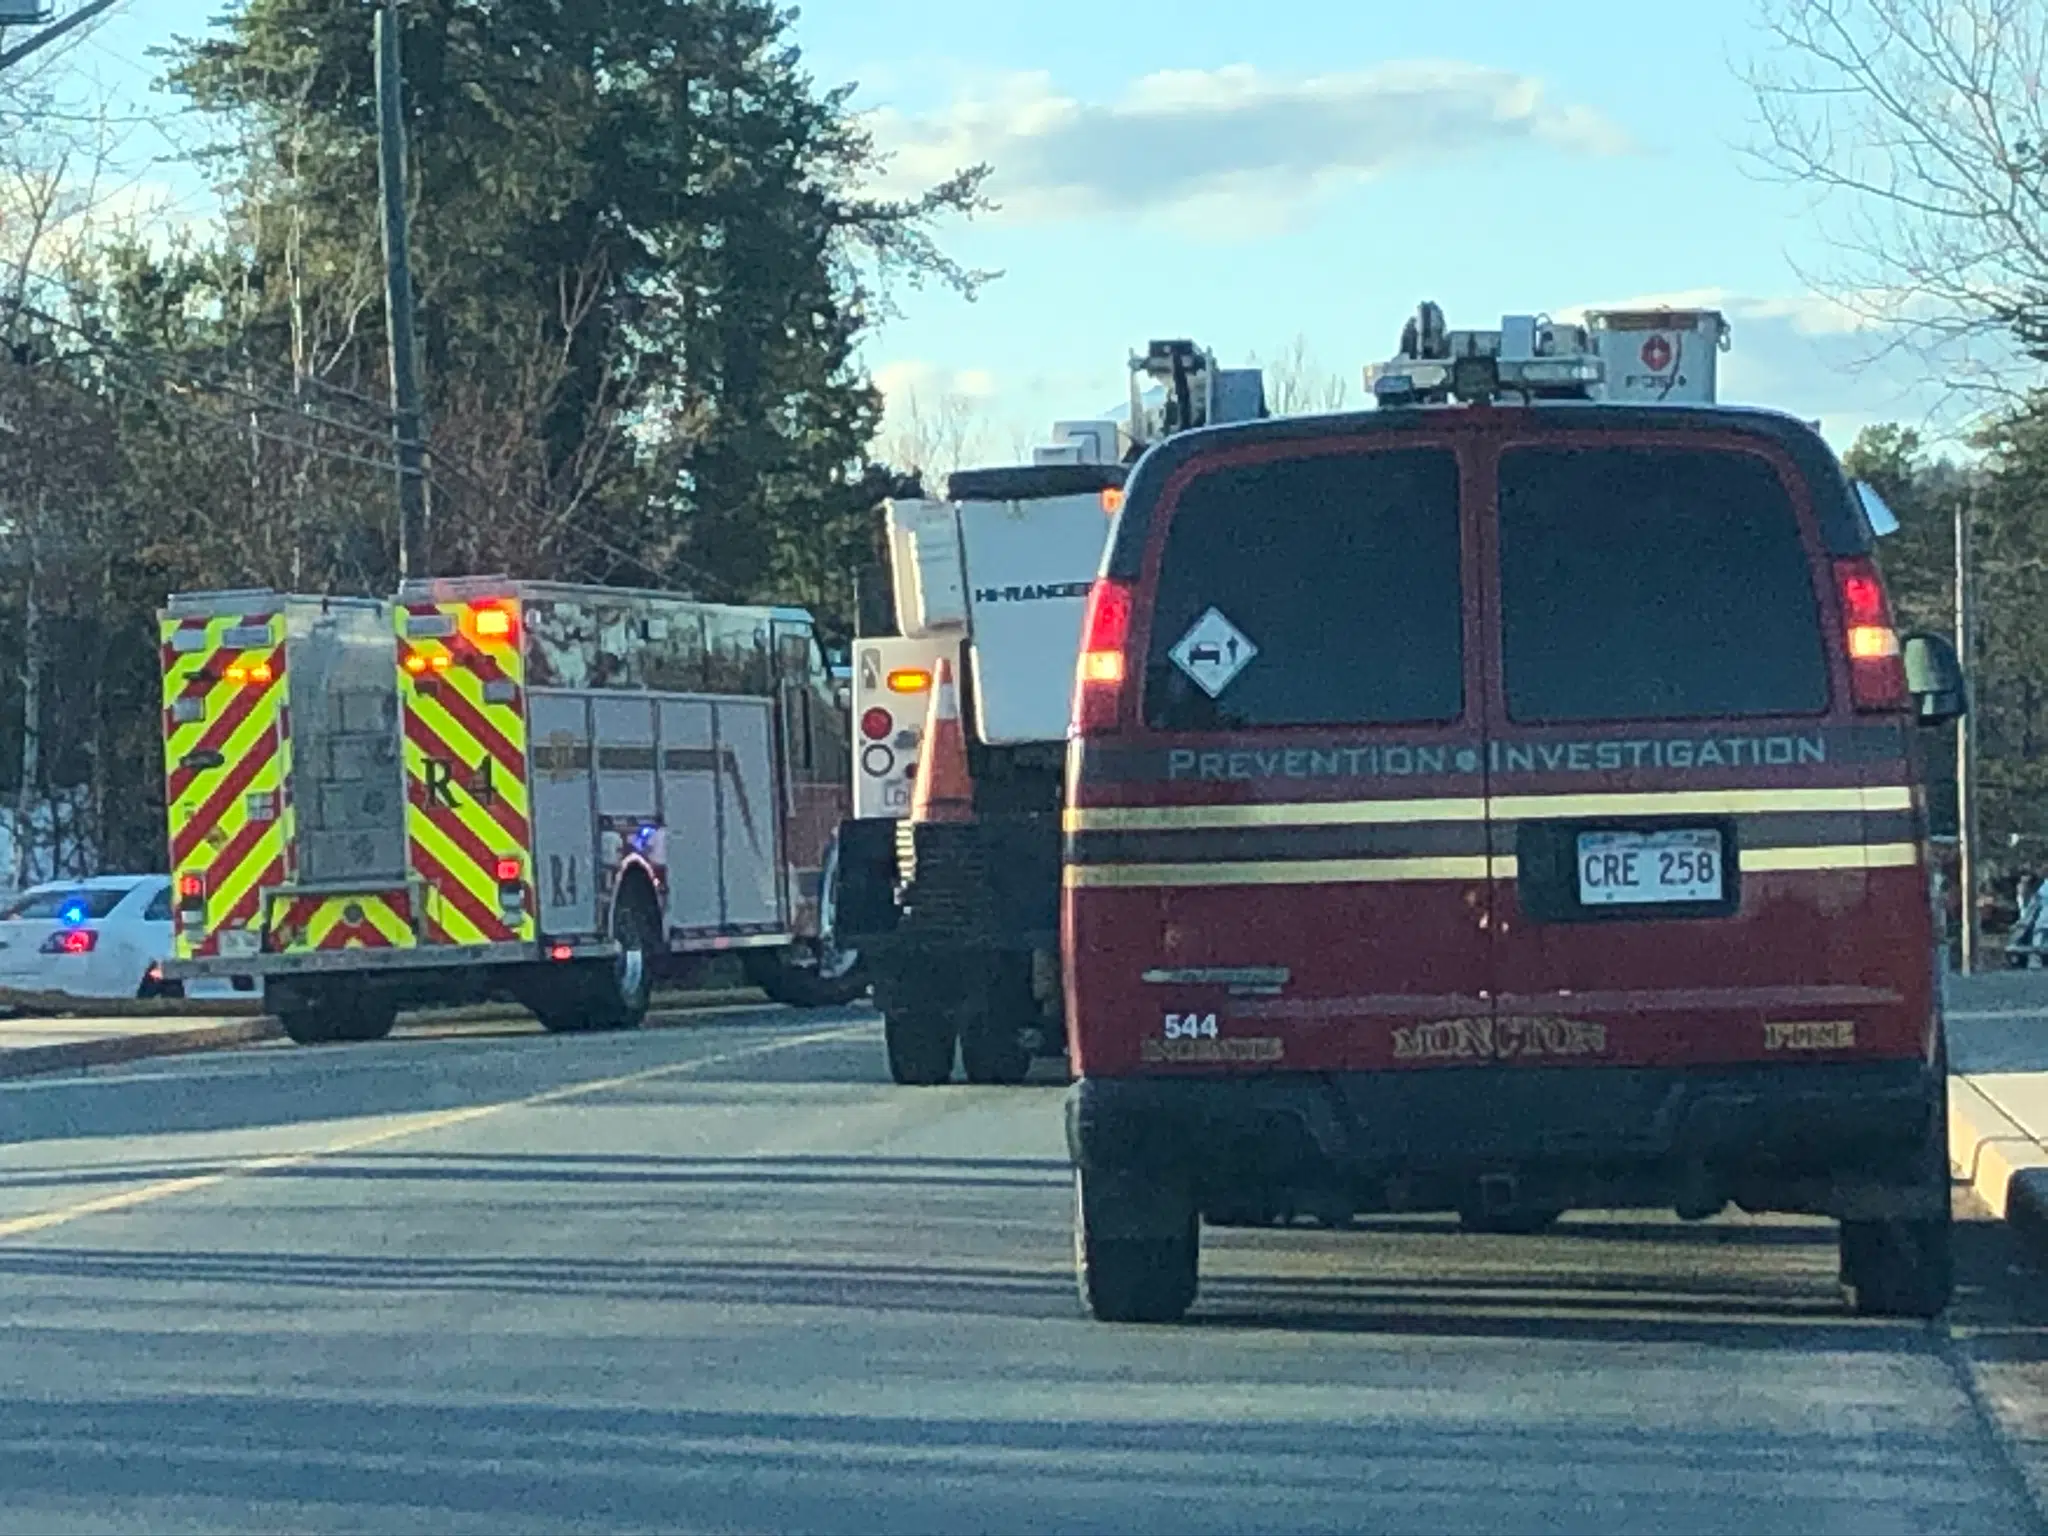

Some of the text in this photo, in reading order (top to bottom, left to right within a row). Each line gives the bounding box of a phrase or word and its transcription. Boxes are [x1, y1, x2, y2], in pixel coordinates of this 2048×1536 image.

[1169, 737, 1825, 780] PREVENTION INVESTIGATION
[551, 854, 577, 907] R4
[1585, 851, 1715, 887] CRE 258
[1164, 1013, 1218, 1039] 544
[1391, 1016, 1606, 1059] MONCTON
